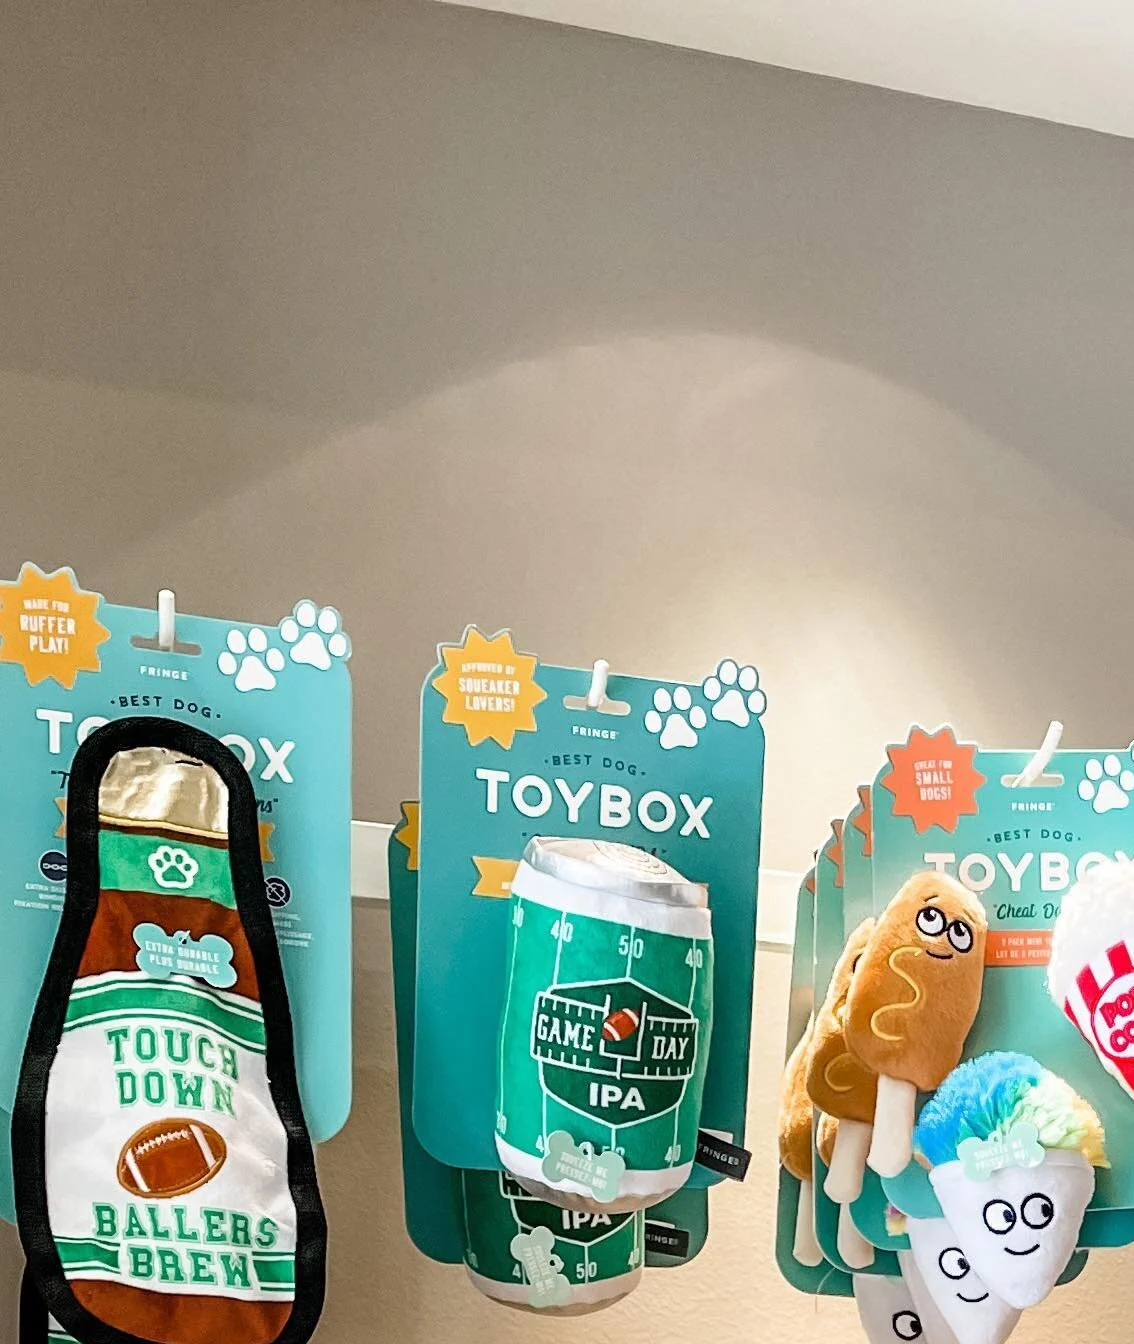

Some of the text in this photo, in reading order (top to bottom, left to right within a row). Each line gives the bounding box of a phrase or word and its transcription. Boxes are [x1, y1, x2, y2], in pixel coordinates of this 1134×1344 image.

[19, 614, 76, 635] RUFFER
[29, 635, 69, 655] PLAY!
[139, 665, 188, 681] FRINGE
[459, 677, 520, 696] SQUEAKER
[118, 695, 213, 719] BEST DOG
[465, 694, 515, 712] LOVERS!
[572, 725, 617, 740] FRINGE
[552, 754, 638, 775] BEST DOG
[915, 770, 954, 786] SMALL
[475, 767, 713, 838] TOYBOX
[919, 784, 952, 802] DOGS!
[1011, 803, 1052, 812] FRINGE
[993, 828, 1076, 843] BEST DOG
[618, 935, 644, 958] 50
[537, 1014, 690, 1060] GAME DAY
[105, 1026, 239, 1081] TOUCH
[117, 1069, 237, 1119] DOWN
[589, 1082, 645, 1111] IPA
[93, 1202, 279, 1248] BALLERS
[128, 1244, 252, 1290] BREW
